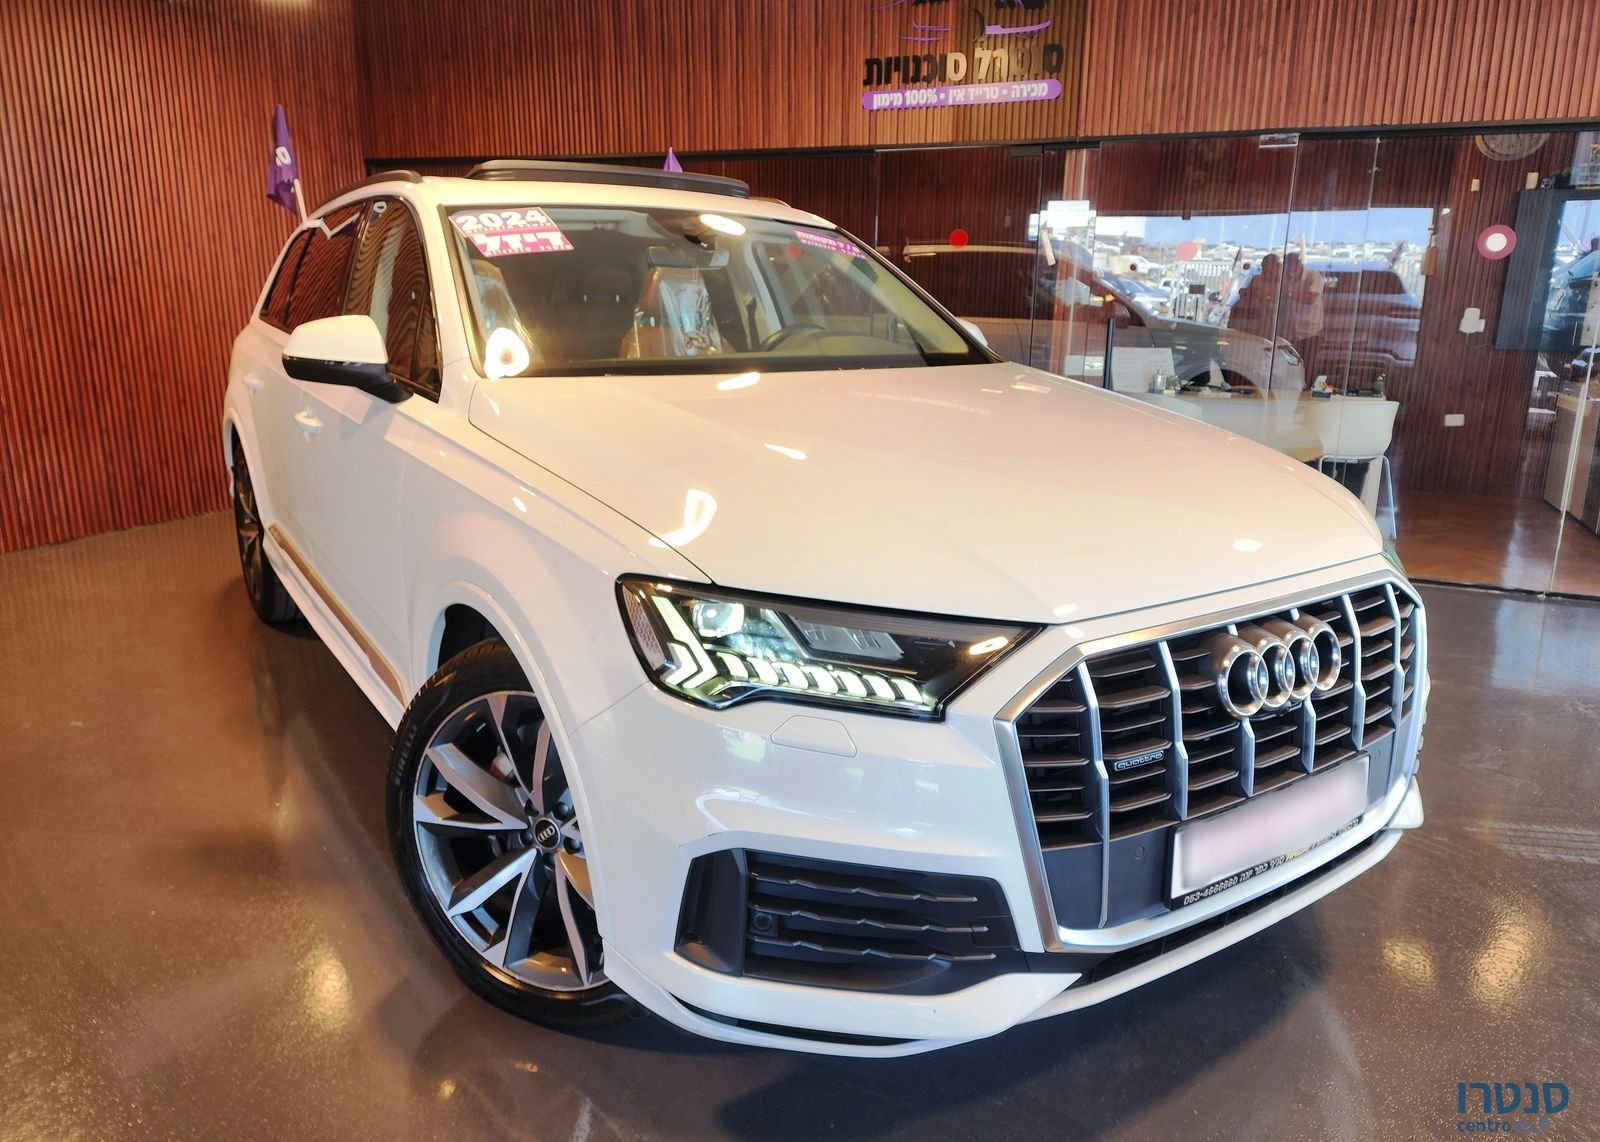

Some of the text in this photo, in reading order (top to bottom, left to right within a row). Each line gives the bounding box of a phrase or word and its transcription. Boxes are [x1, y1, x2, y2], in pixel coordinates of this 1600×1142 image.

[863, 43, 1064, 86] סנטרל סוכנויות
[872, 82, 1049, 110] מכירה טרייד אין 100% מימון
[456, 209, 548, 231] 2024
[472, 231, 564, 252] דיזל
[1117, 753, 1163, 769] quattro
